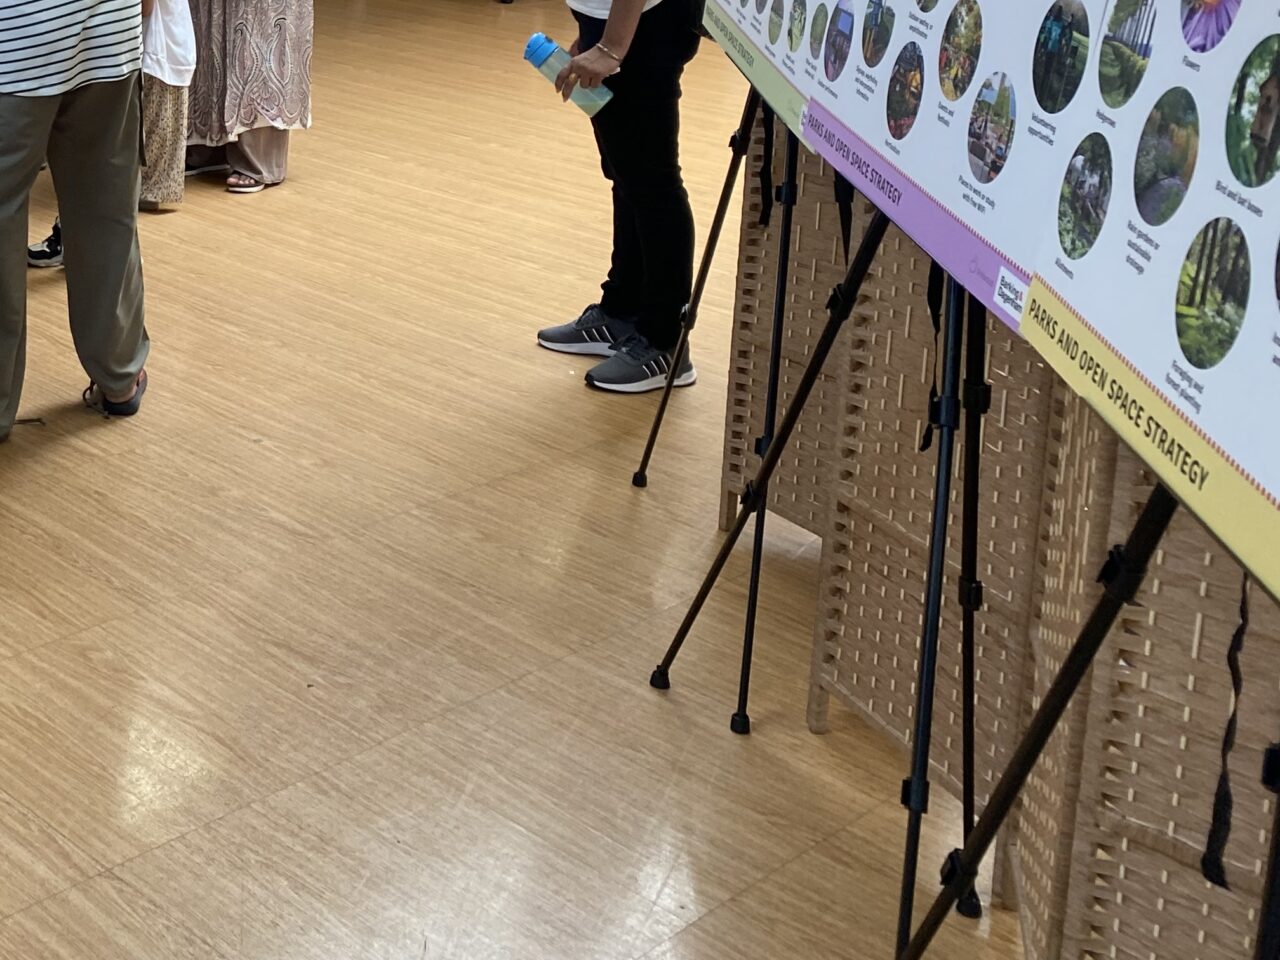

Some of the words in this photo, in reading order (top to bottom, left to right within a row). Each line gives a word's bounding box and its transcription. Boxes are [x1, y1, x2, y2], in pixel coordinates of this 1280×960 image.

[808, 114, 824, 137] PARKS
[823, 129, 835, 148] AND
[835, 137, 851, 162] OPEN
[850, 151, 870, 179] SPACE
[869, 168, 903, 206] STRATEGY
[1000, 275, 1020, 301] Barking
[1028, 299, 1058, 339] PARKS
[1056, 328, 1079, 361] AND
[1079, 350, 1108, 391] OPEN
[1107, 379, 1145, 428] SPACE
[1144, 415, 1210, 491] STRATEGY
